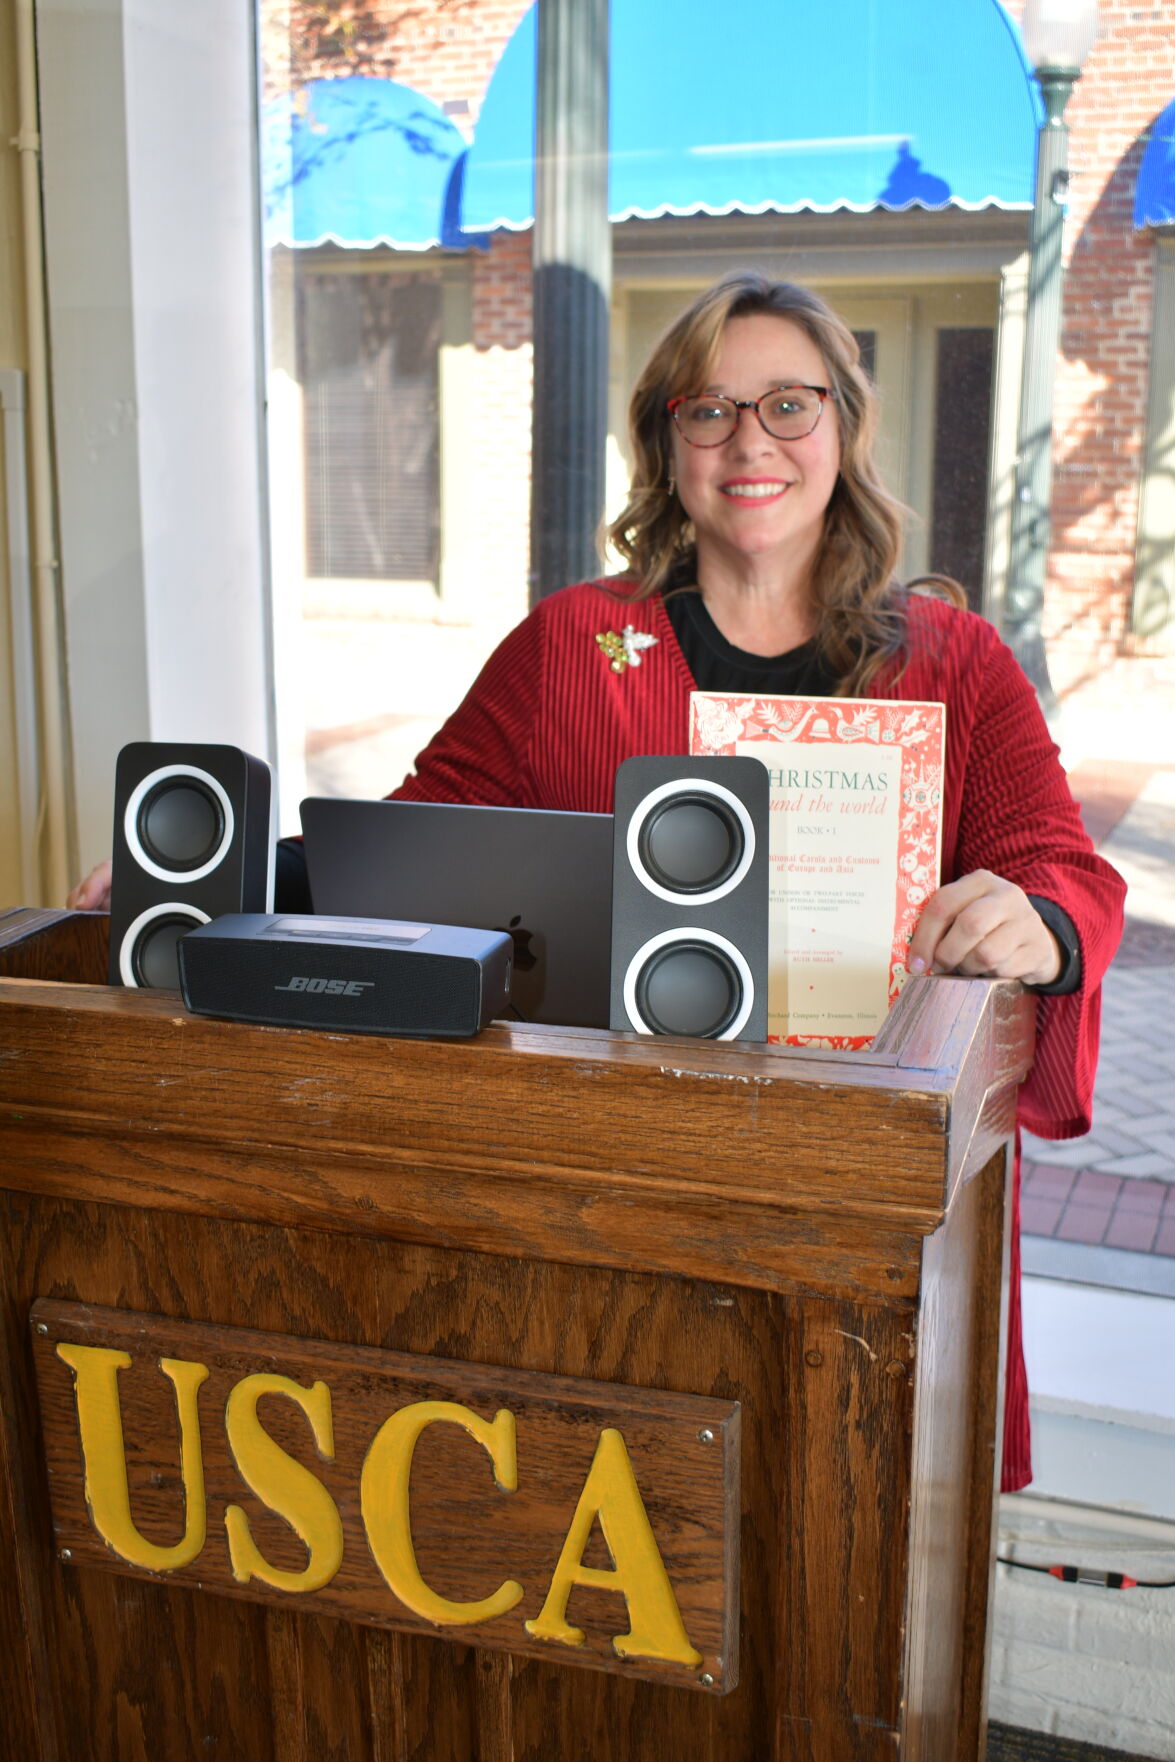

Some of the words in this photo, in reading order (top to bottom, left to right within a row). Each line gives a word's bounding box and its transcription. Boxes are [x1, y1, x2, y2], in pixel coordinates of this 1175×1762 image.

[769, 769, 888, 791] HRISTMAS
[769, 793, 804, 812] und
[808, 794, 833, 813] the
[840, 795, 888, 815] world
[776, 864, 785, 872] of
[819, 865, 833, 873] and
[829, 855, 843, 863] and
[275, 976, 375, 997] BOSE
[56, 1343, 703, 1668] USCA
